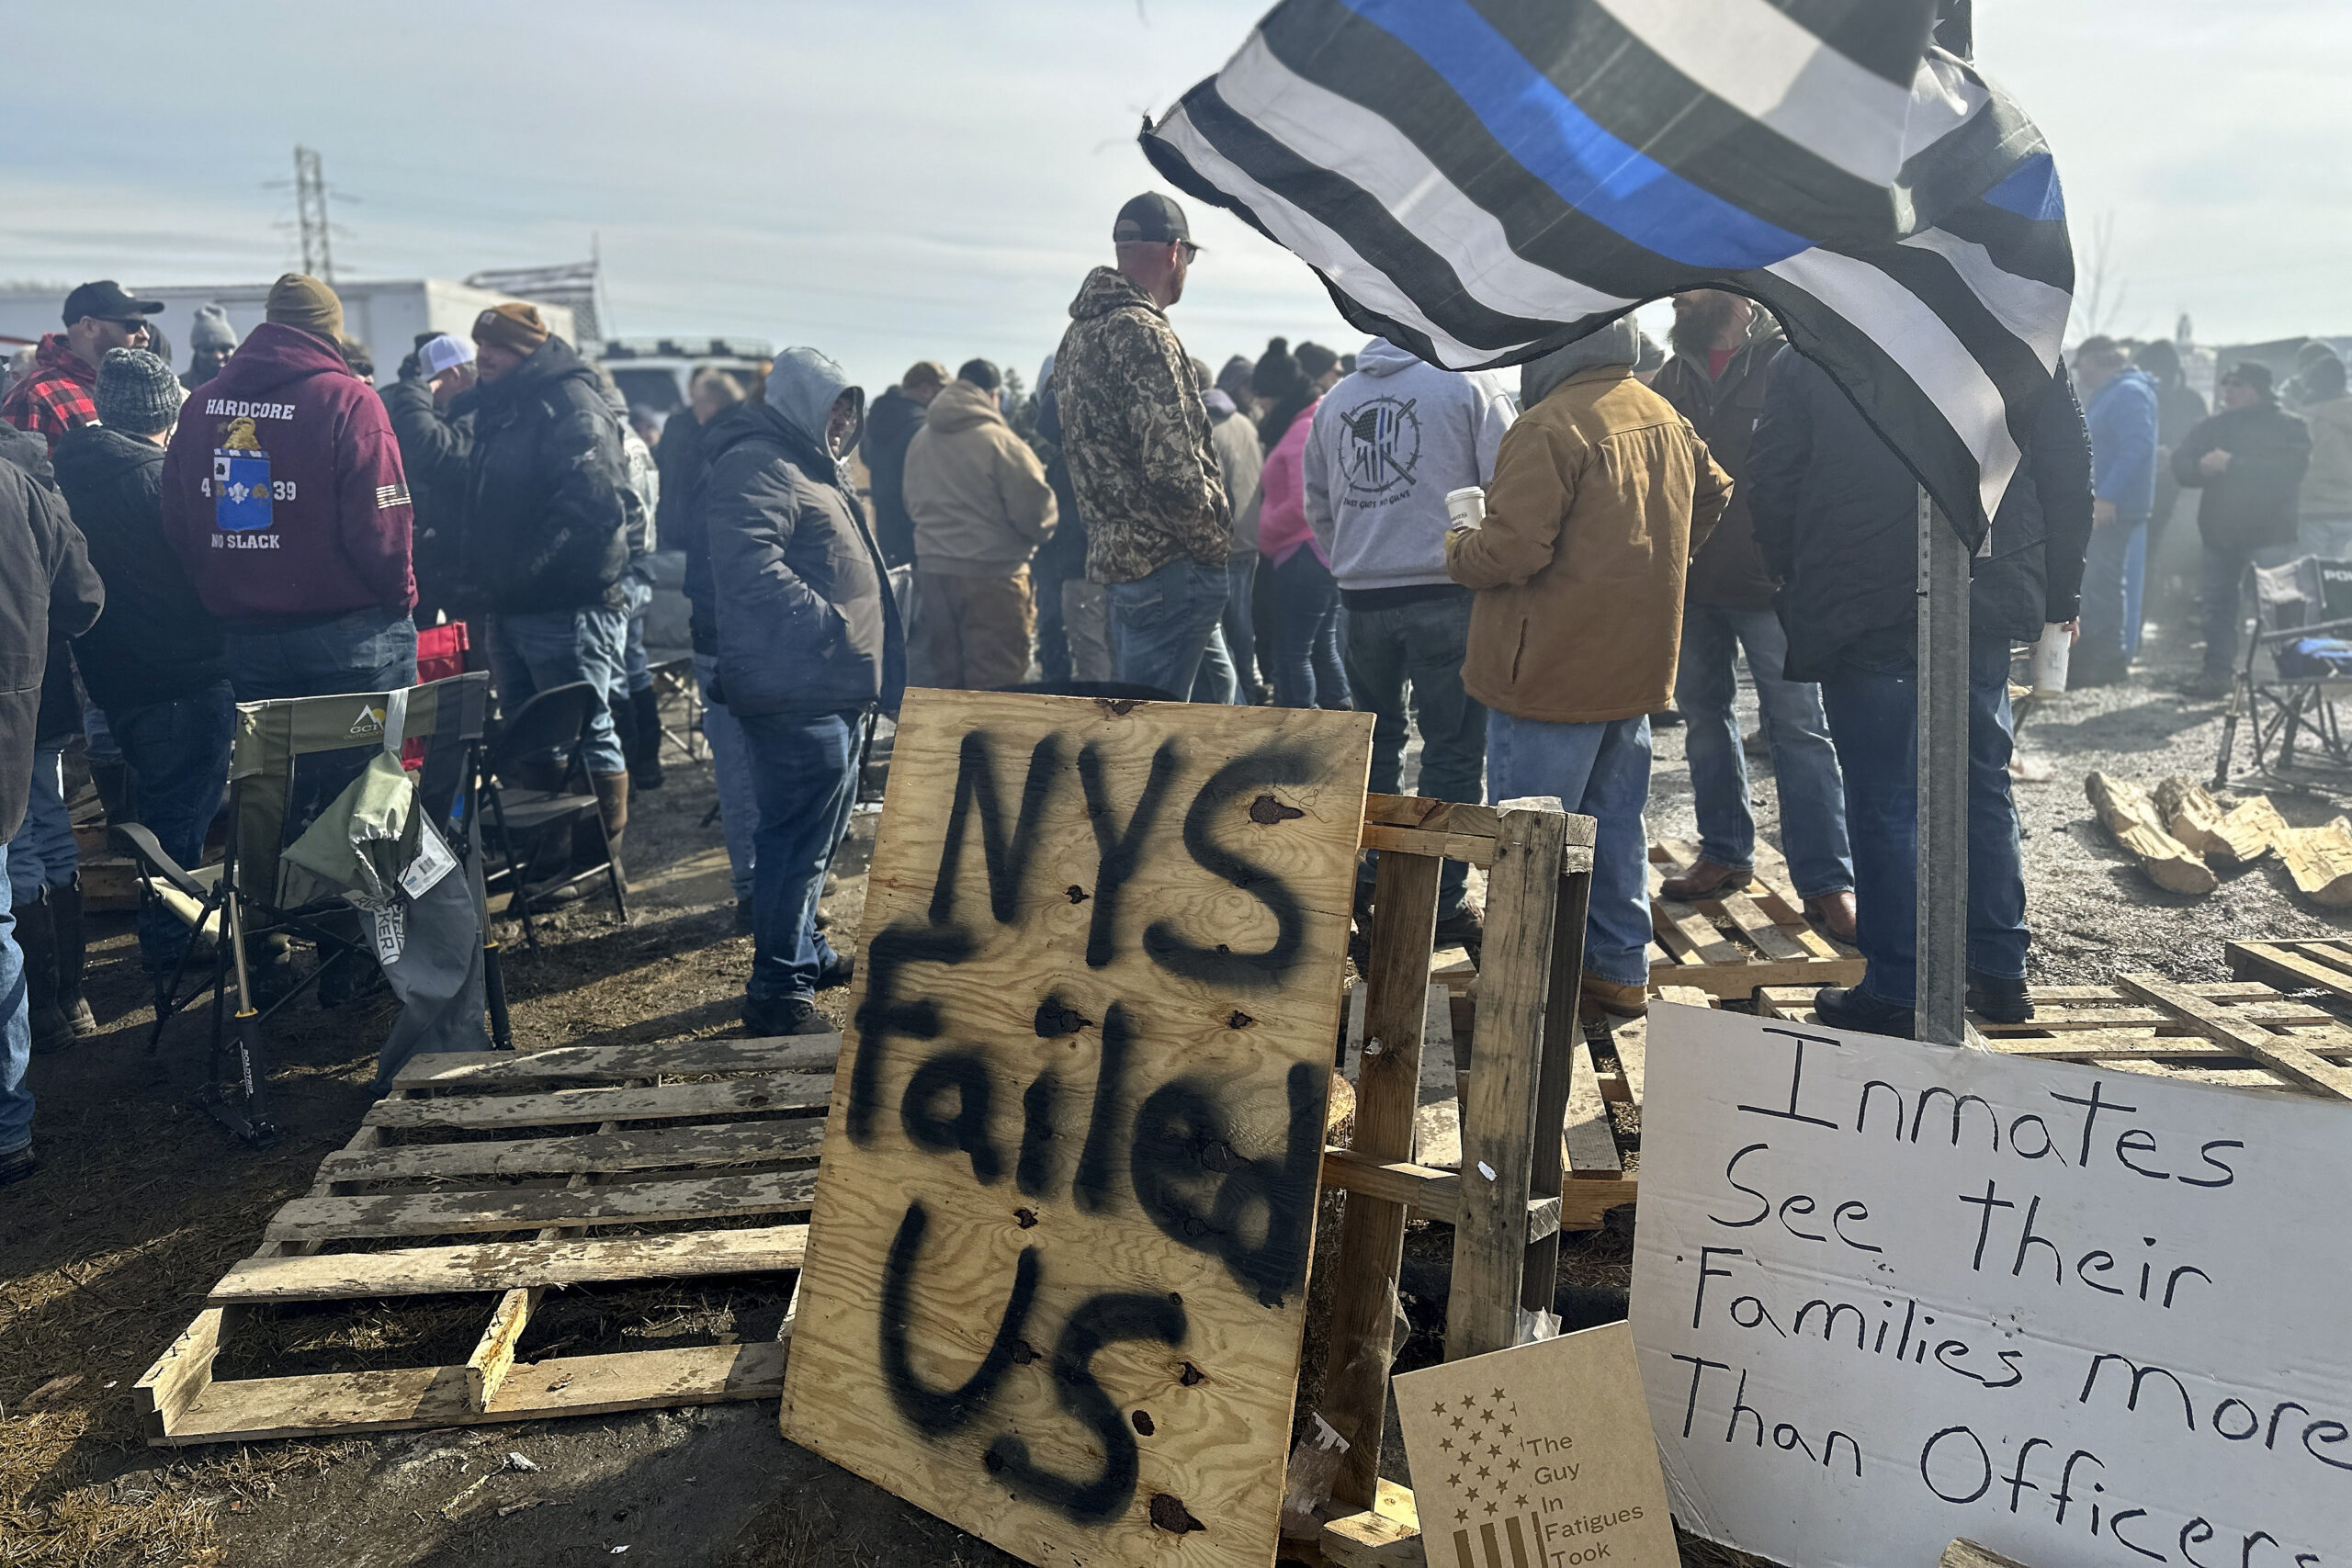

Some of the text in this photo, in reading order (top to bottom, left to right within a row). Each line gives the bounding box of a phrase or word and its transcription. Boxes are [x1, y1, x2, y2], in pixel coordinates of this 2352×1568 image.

[205, 399, 296, 421] HARDCORE
[201, 477, 297, 501] 4 39
[1389, 490, 1411, 504] GUNS
[211, 534, 280, 549] NO SLACK
[928, 732, 1321, 987] NYS
[845, 921, 1329, 1308] Failed
[1737, 1027, 2245, 1188] Inmates
[1707, 1143, 1883, 1254] See
[1692, 1246, 2023, 1388] Families
[1670, 1353, 1862, 1477] Than
[1526, 1436, 1573, 1457] The
[1534, 1462, 1580, 1484] Guy
[1541, 1496, 1564, 1514] In
[1544, 1506, 1645, 1542] Fatigues
[1550, 1541, 1611, 1568] Took
